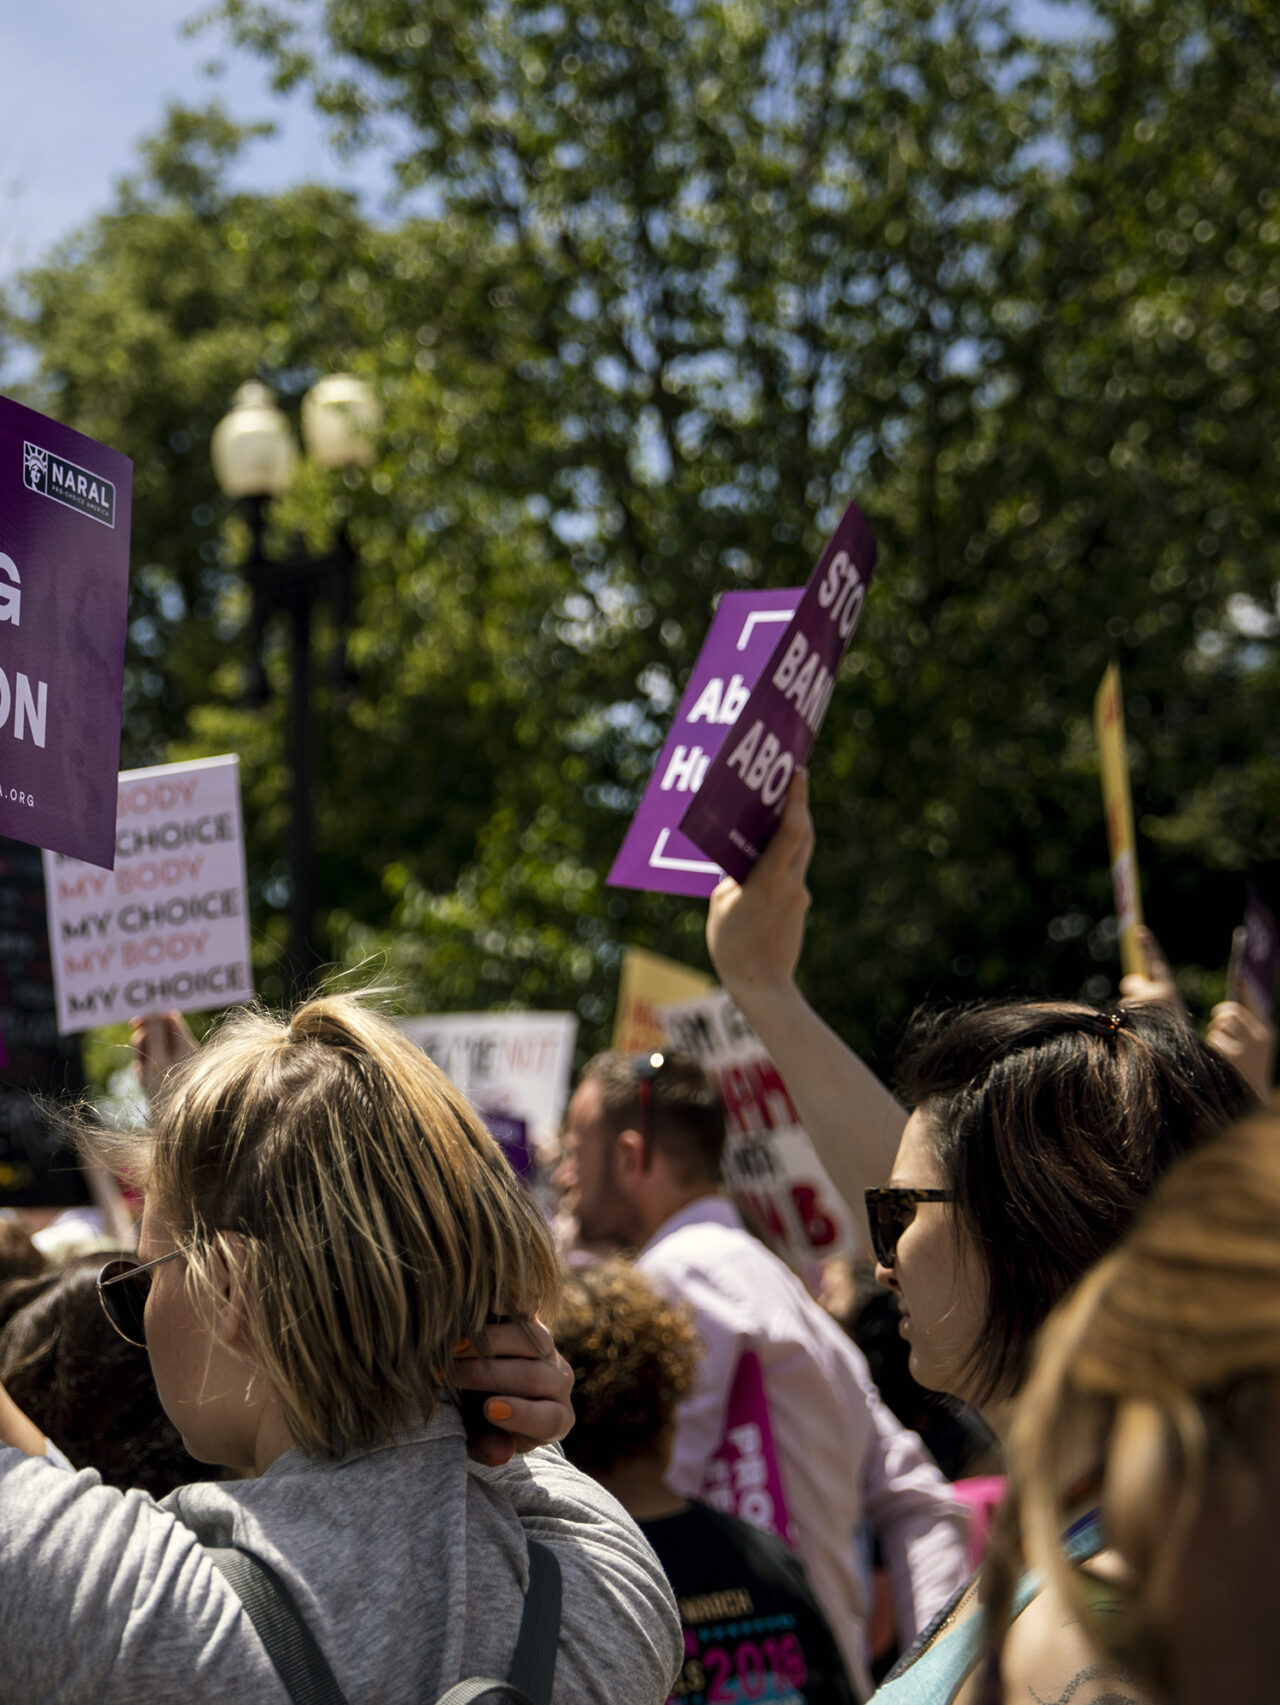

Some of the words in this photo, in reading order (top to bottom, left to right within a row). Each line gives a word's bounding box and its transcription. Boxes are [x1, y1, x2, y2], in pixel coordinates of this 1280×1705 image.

[52, 462, 110, 509] NARAL
[818, 550, 866, 640] STO
[726, 719, 795, 807] ABO
[116, 811, 233, 858] CHOICE
[57, 872, 109, 902] MY
[115, 852, 205, 895] BODY
[61, 909, 112, 942] MY
[117, 887, 239, 934] CHOICE
[63, 943, 114, 979] MY
[120, 927, 211, 970] BODY
[67, 982, 119, 1016] MY
[123, 961, 245, 1009] CHOICE
